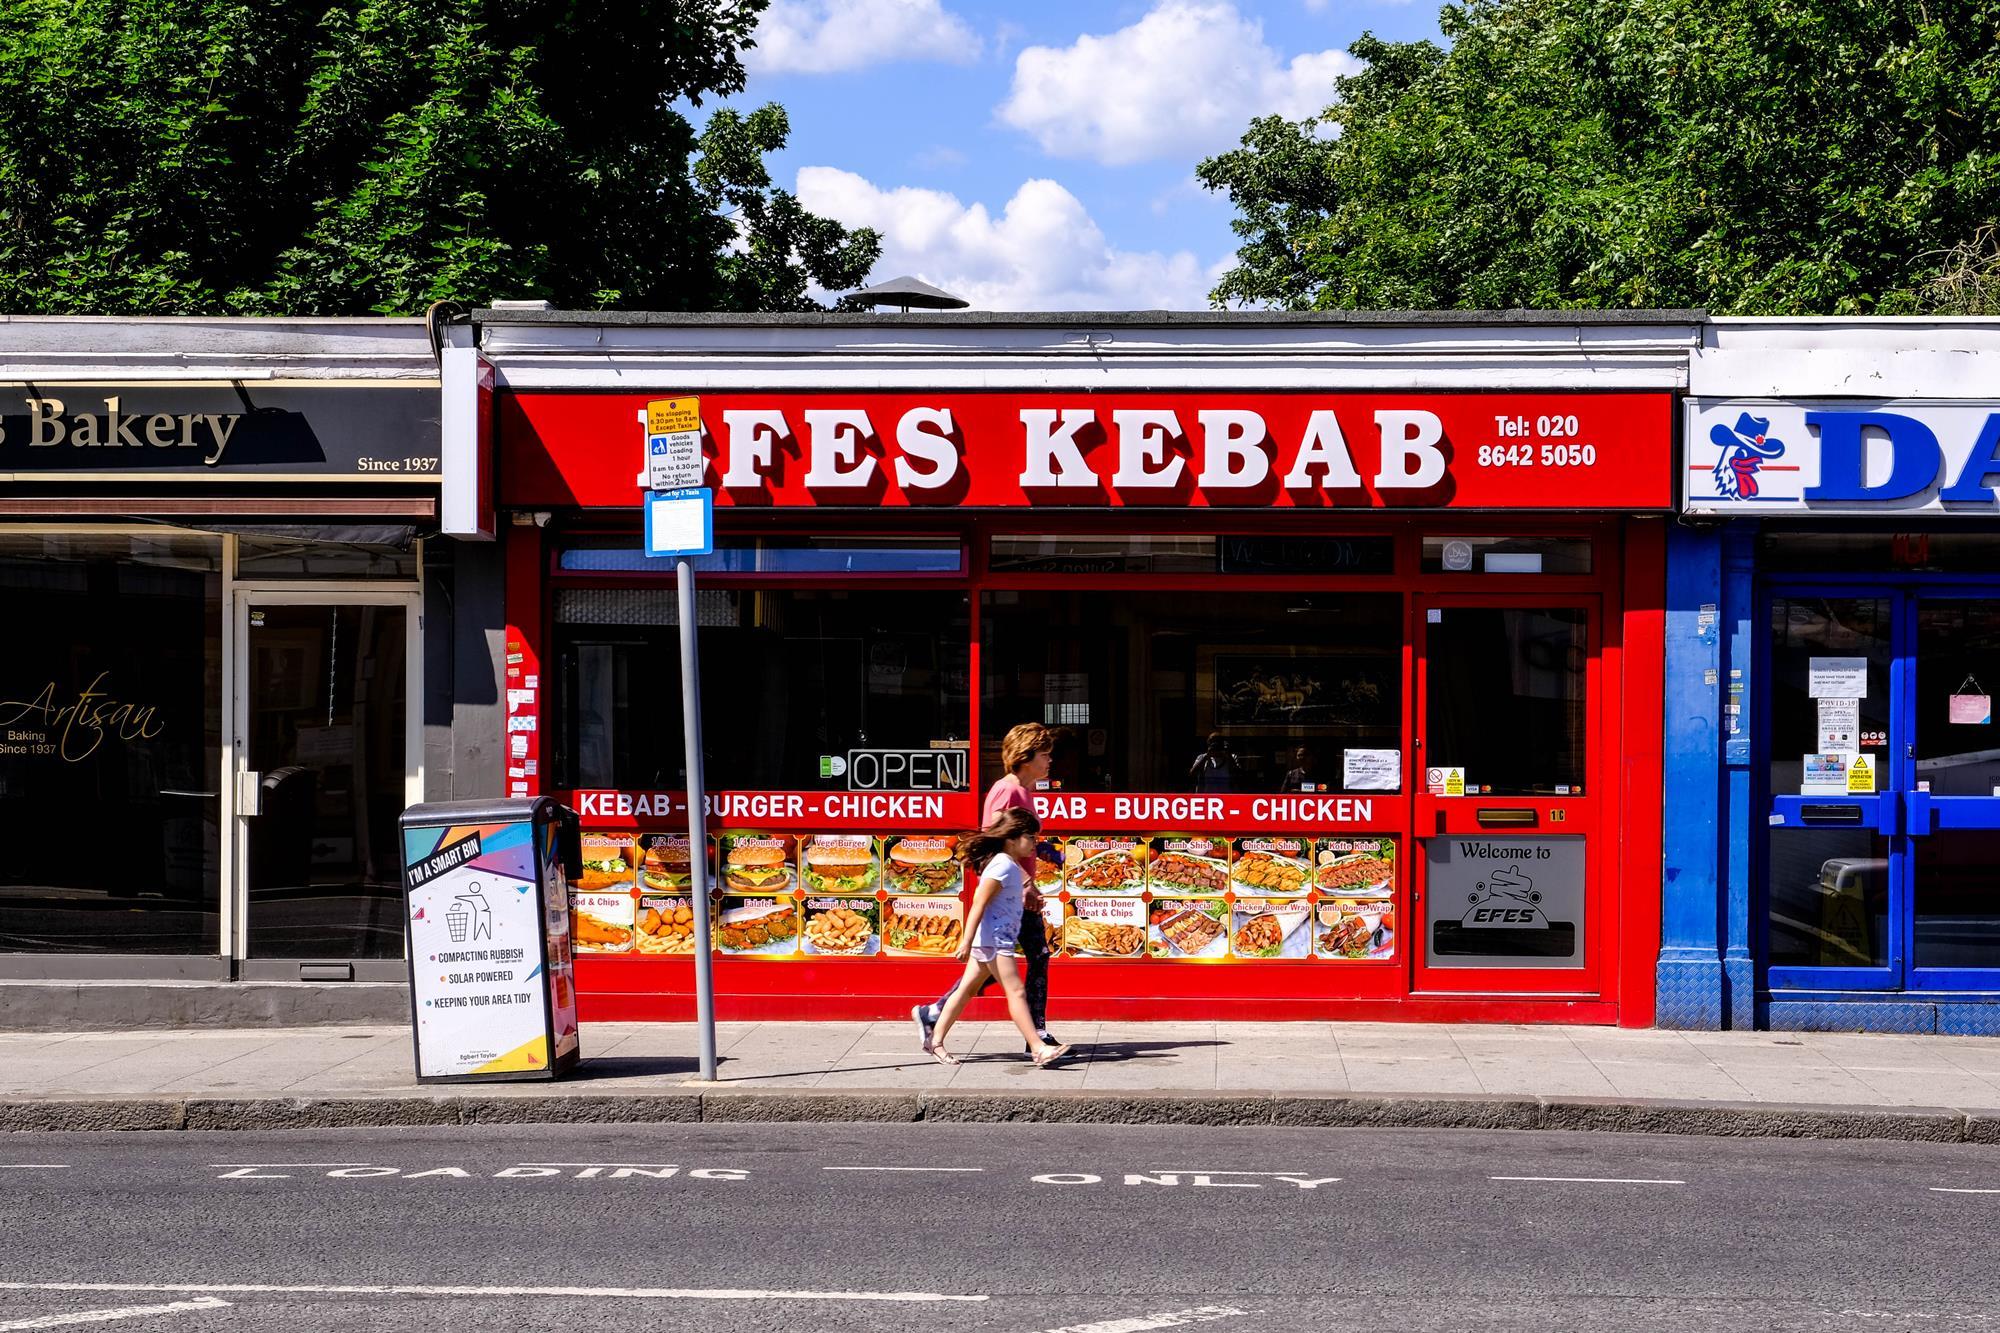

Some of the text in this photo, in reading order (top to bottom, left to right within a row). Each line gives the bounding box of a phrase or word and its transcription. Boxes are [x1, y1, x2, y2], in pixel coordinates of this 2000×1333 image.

[26, 396, 240, 464] Bakery
[1495, 415, 1578, 437] Tel: 020
[637, 406, 1448, 488] FES KEBAB
[1478, 444, 1596, 466] 8642 5050
[357, 457, 438, 471] Since 1937
[674, 478, 681, 486] 2
[0, 671, 164, 762] Artisan
[8, 730, 46, 743] Baking
[31, 744, 56, 754] 1937
[853, 753, 961, 790] OPEN
[580, 793, 670, 816] KEBAB
[824, 795, 943, 819] CHICKEN
[1033, 796, 1087, 819] BAB
[1114, 797, 1225, 820] BURGER
[1252, 798, 1372, 822] CHICKEN
[603, 838, 634, 846] Sandwich
[652, 837, 689, 847] 1/2 Poun
[733, 838, 785, 847] 1/4 Pounder
[815, 839, 867, 849] Vege Burger
[901, 839, 945, 848] Doner Roll
[1076, 840, 1136, 850] Chicken Doner
[1164, 840, 1213, 850] Lamb Shish
[1242, 841, 1301, 850] Chicken Shish
[1329, 841, 1380, 850] Kofte Kebab
[1460, 842, 1551, 859] Welcome to
[408, 838, 480, 886] I'M A SMART BIN
[588, 898, 595, 906] &
[597, 898, 620, 907] Chips
[642, 898, 677, 907] Nuggets
[743, 899, 773, 908] Falafel
[808, 900, 874, 910] Scampi & Chips
[893, 901, 953, 911] Chicken Wings
[1076, 899, 1136, 908] Chicken Doner
[1163, 900, 1213, 911] Efes Special
[1078, 908, 1134, 918] Meat & Chips
[1232, 903, 1310, 913] Chicken Doner Wrap
[1317, 903, 1340, 911] Lamb
[1369, 904, 1391, 913] Wrap
[1473, 908, 1537, 923] EFES
[438, 950, 488, 963] COMPACTING
[489, 948, 524, 960] RUBBISH
[448, 970, 513, 984] SOLAR POWERED
[434, 993, 532, 1009] KEEPING YOUR AREA TIDY
[217, 1167, 1343, 1189] LOADING ONLY
